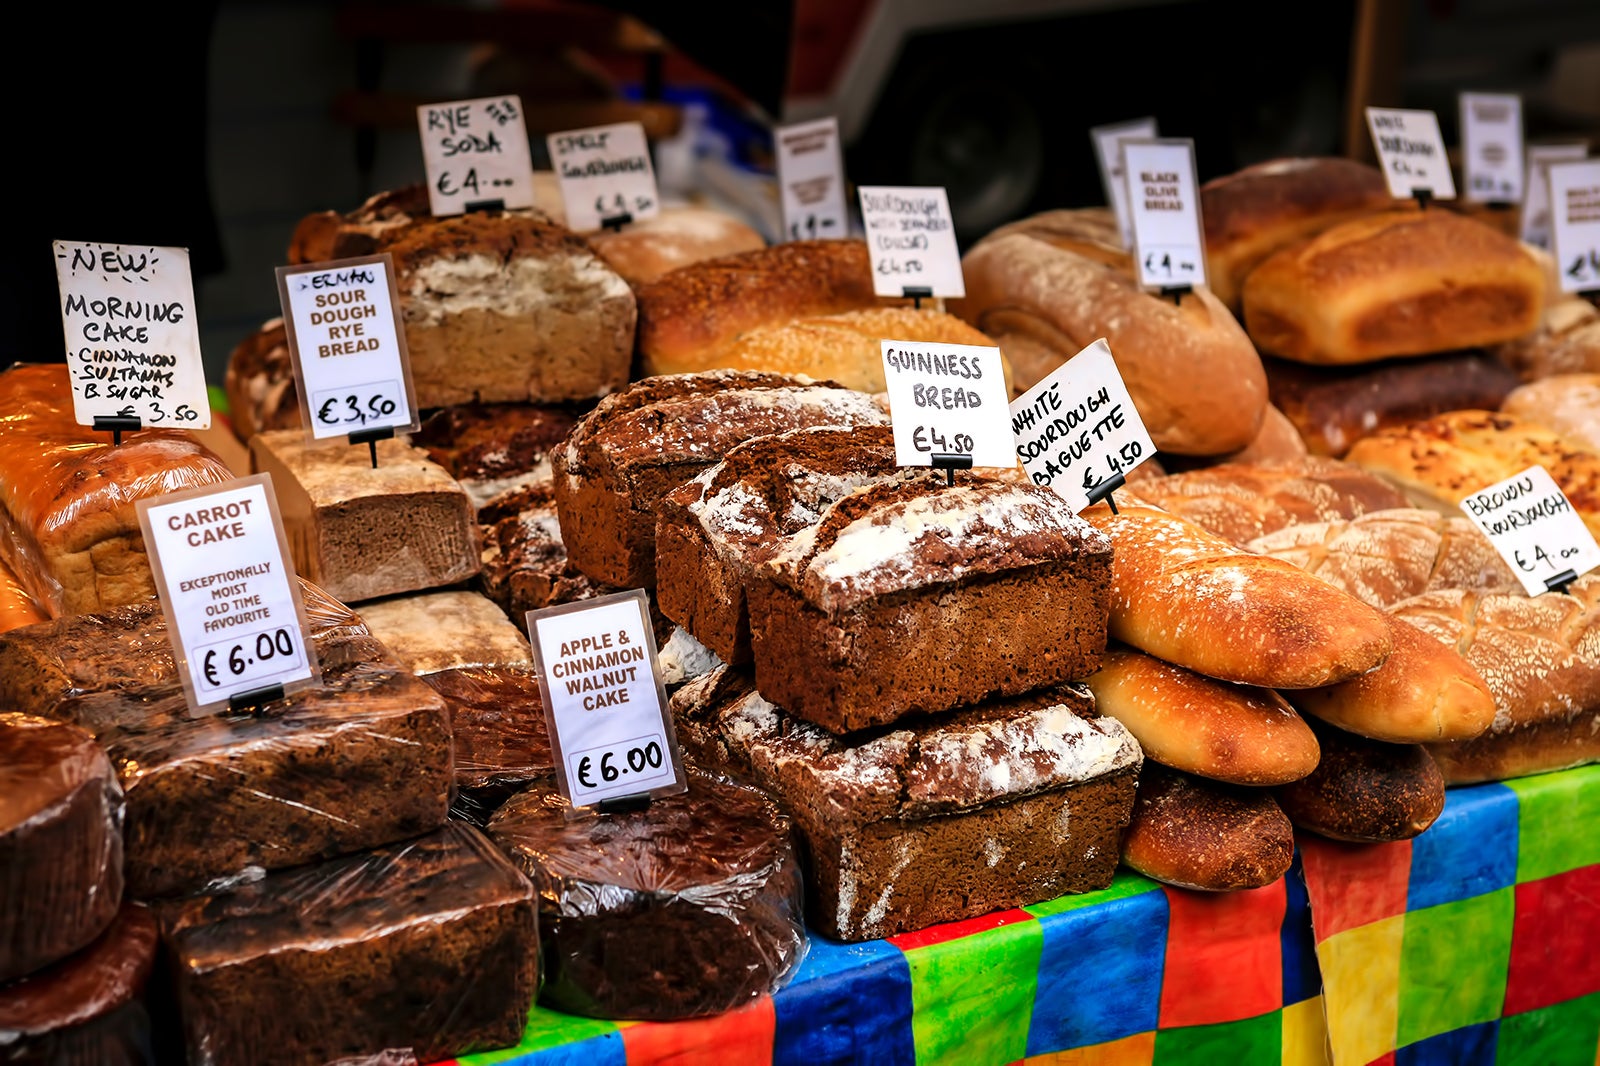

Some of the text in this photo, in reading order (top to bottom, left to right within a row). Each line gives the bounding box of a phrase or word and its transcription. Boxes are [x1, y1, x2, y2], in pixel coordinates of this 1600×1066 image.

[428, 105, 471, 135] RYE
[441, 130, 502, 157] SODA
[1140, 171, 1180, 183] BLACK
[1145, 187, 1179, 198] OLIVE
[1145, 201, 1184, 212] BREAD
[72, 249, 147, 273] NEW
[65, 294, 184, 324] MORNING
[315, 289, 366, 307] SOUR
[310, 305, 377, 325] DOUGH
[83, 322, 149, 343] CAKE
[329, 323, 364, 340] RYE
[79, 347, 177, 367] CINNAMON
[318, 338, 380, 358] BREAD
[79, 364, 174, 388] SULTANAS
[887, 348, 982, 379] GUINNESS
[106, 384, 164, 400] SUGAR
[913, 383, 981, 410] BREAD
[1012, 382, 1062, 435] WHITE
[1016, 386, 1111, 465] SOURDOUGH
[912, 426, 974, 454] €4.50
[1032, 404, 1125, 487] BAGUETTE
[1465, 476, 1533, 516] BROWN
[168, 499, 253, 531] CARROT
[1481, 492, 1570, 535] SOURDOUGH
[187, 522, 245, 548] CAKE
[179, 562, 271, 593] EXCEPTIONALLY
[211, 582, 248, 600] MOIST
[205, 594, 261, 617] OLD TIME
[203, 607, 271, 633] FAVOURITE
[560, 630, 630, 658] APPLE &
[552, 646, 645, 679] CINNAMON
[565, 666, 637, 695] WALNUT
[583, 688, 630, 711] CAKE
